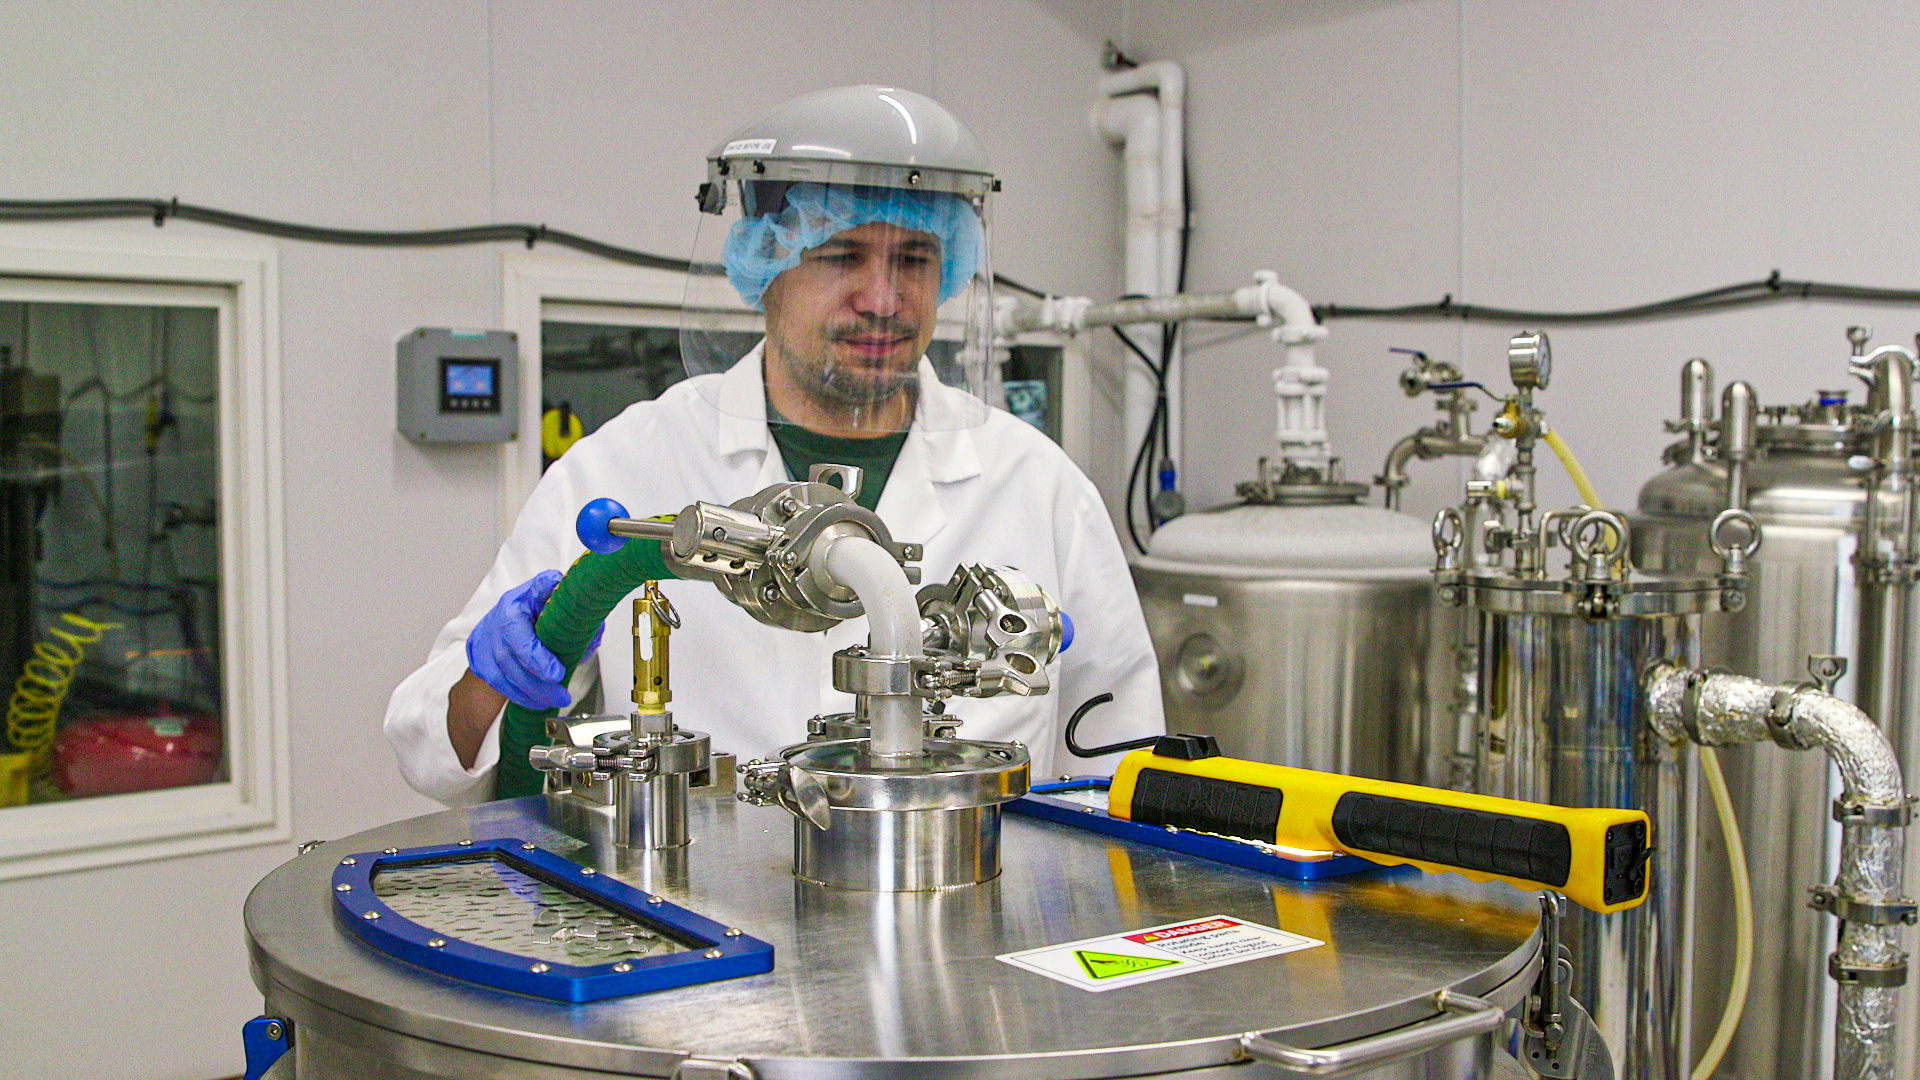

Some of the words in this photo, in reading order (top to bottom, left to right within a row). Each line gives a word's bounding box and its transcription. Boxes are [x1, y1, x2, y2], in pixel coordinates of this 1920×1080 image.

[1153, 920, 1230, 938] DANGER
[1155, 935, 1211, 947] Rotating
[1210, 929, 1241, 938] parts
[1202, 952, 1235, 960] before
